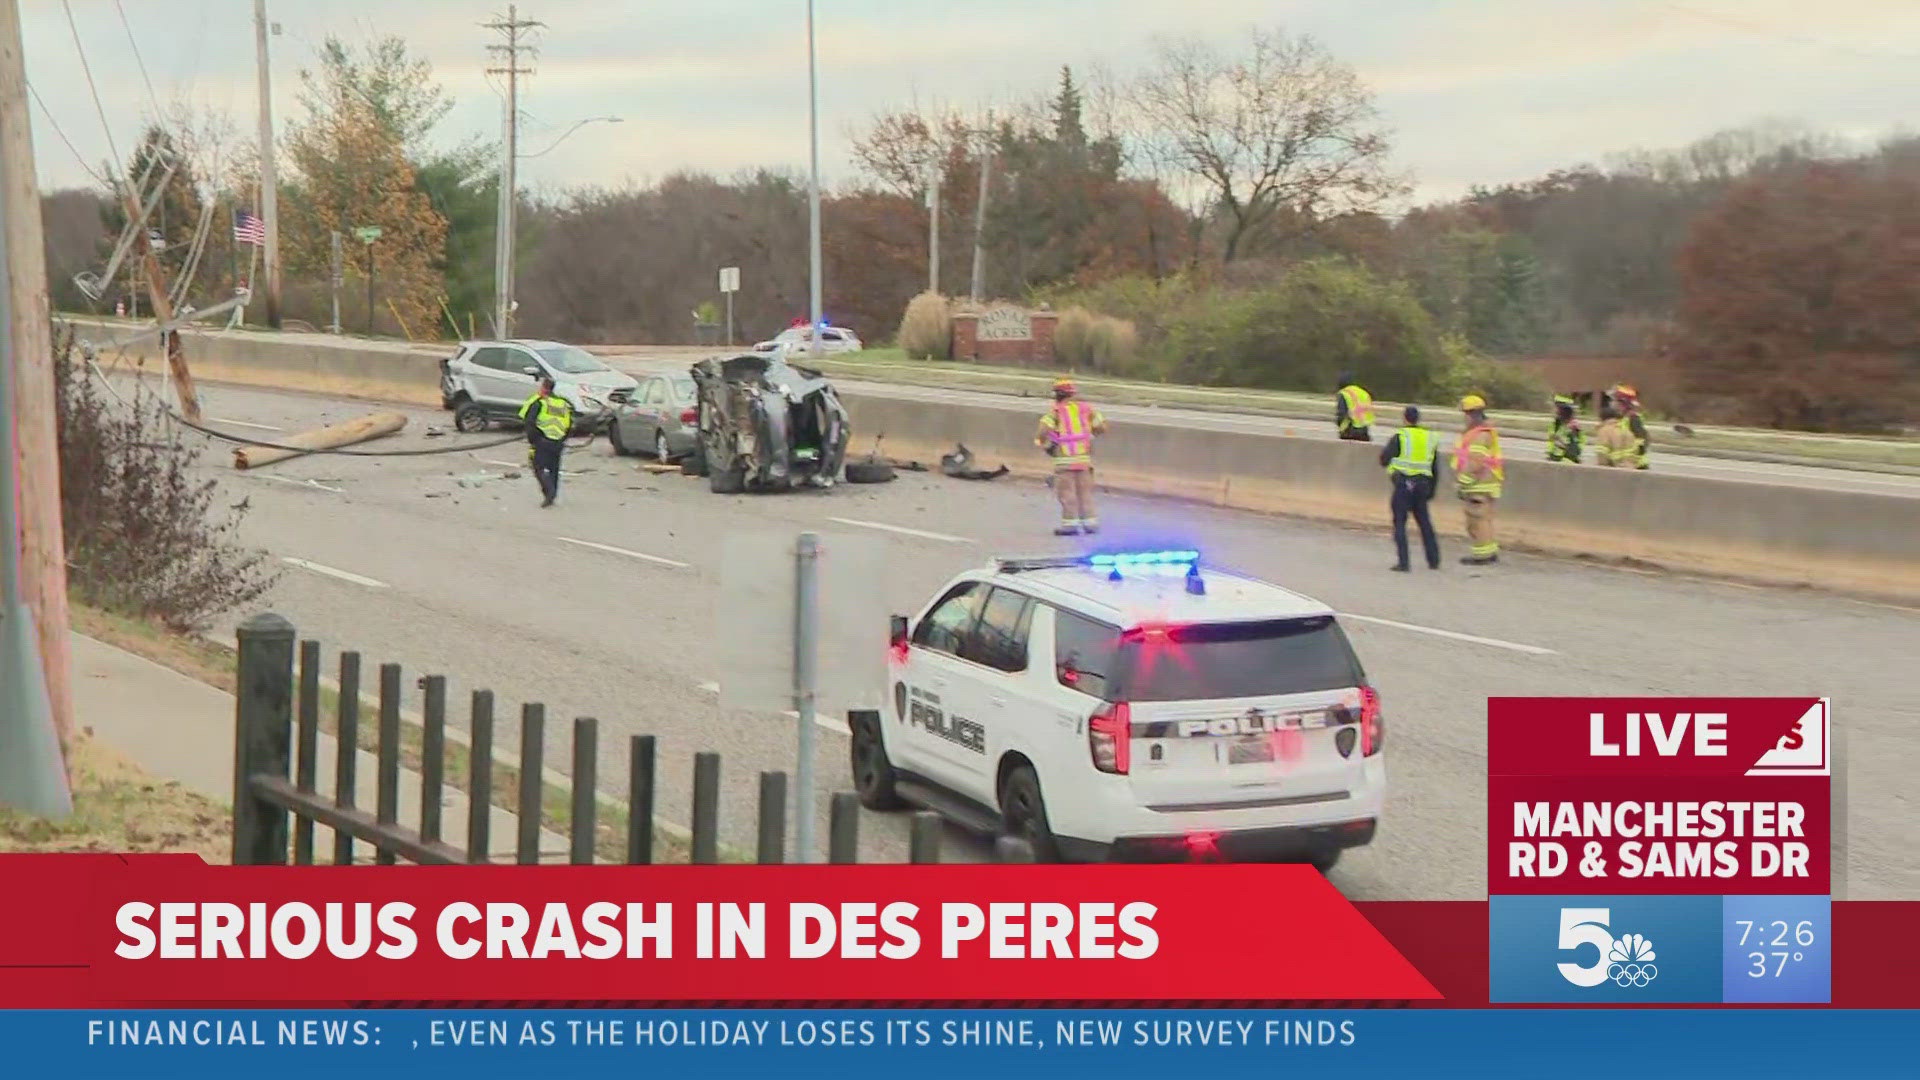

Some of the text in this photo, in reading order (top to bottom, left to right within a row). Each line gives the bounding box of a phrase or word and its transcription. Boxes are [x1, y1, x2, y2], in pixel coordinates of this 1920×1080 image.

[982, 308, 1029, 326] ROYAL
[983, 327, 1029, 338] ACRES
[911, 699, 986, 755] POLICE
[1178, 714, 1327, 738] POLICE
